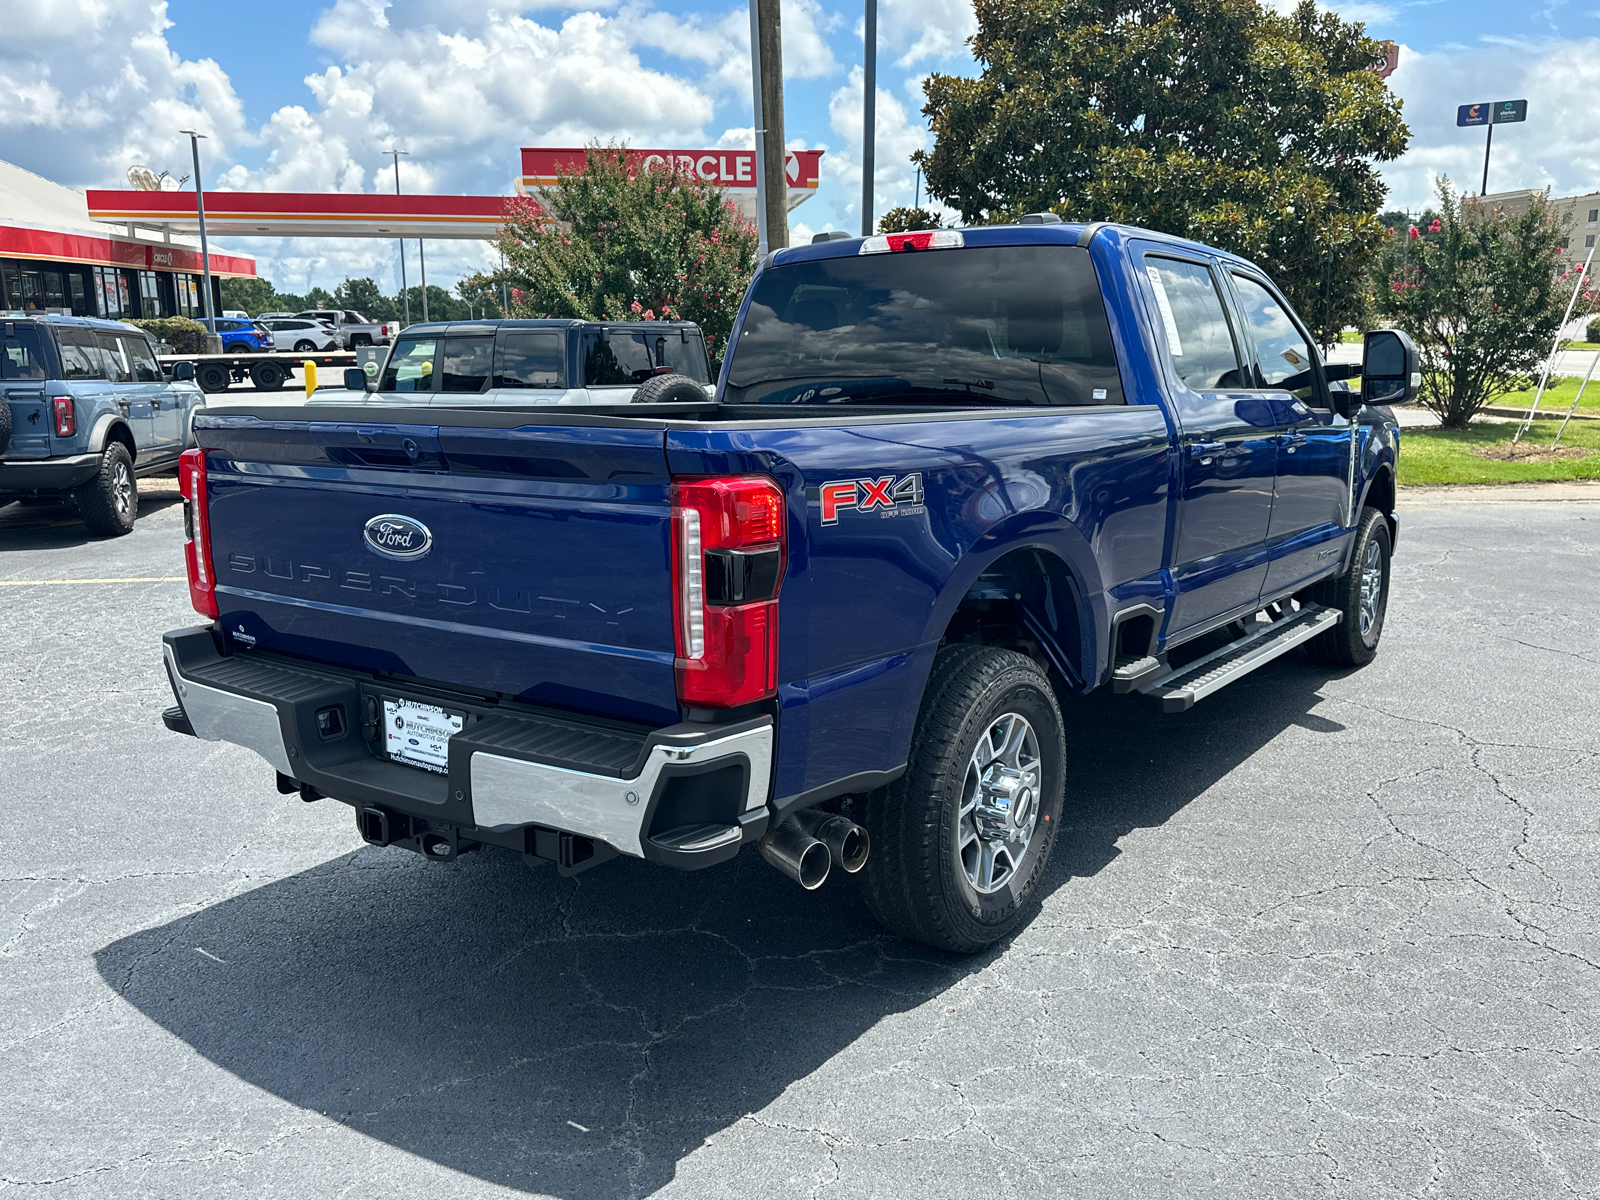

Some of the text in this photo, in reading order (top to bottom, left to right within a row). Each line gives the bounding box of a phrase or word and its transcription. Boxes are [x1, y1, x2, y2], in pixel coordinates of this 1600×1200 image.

[820, 472, 925, 527] FX4
[880, 506, 924, 519] OFF ROAD
[377, 522, 413, 547] Ford
[229, 552, 635, 626] SUPER DUTY
[405, 700, 443, 714] HUTCHINSON
[407, 730, 435, 741] AUTOMOTIVE
